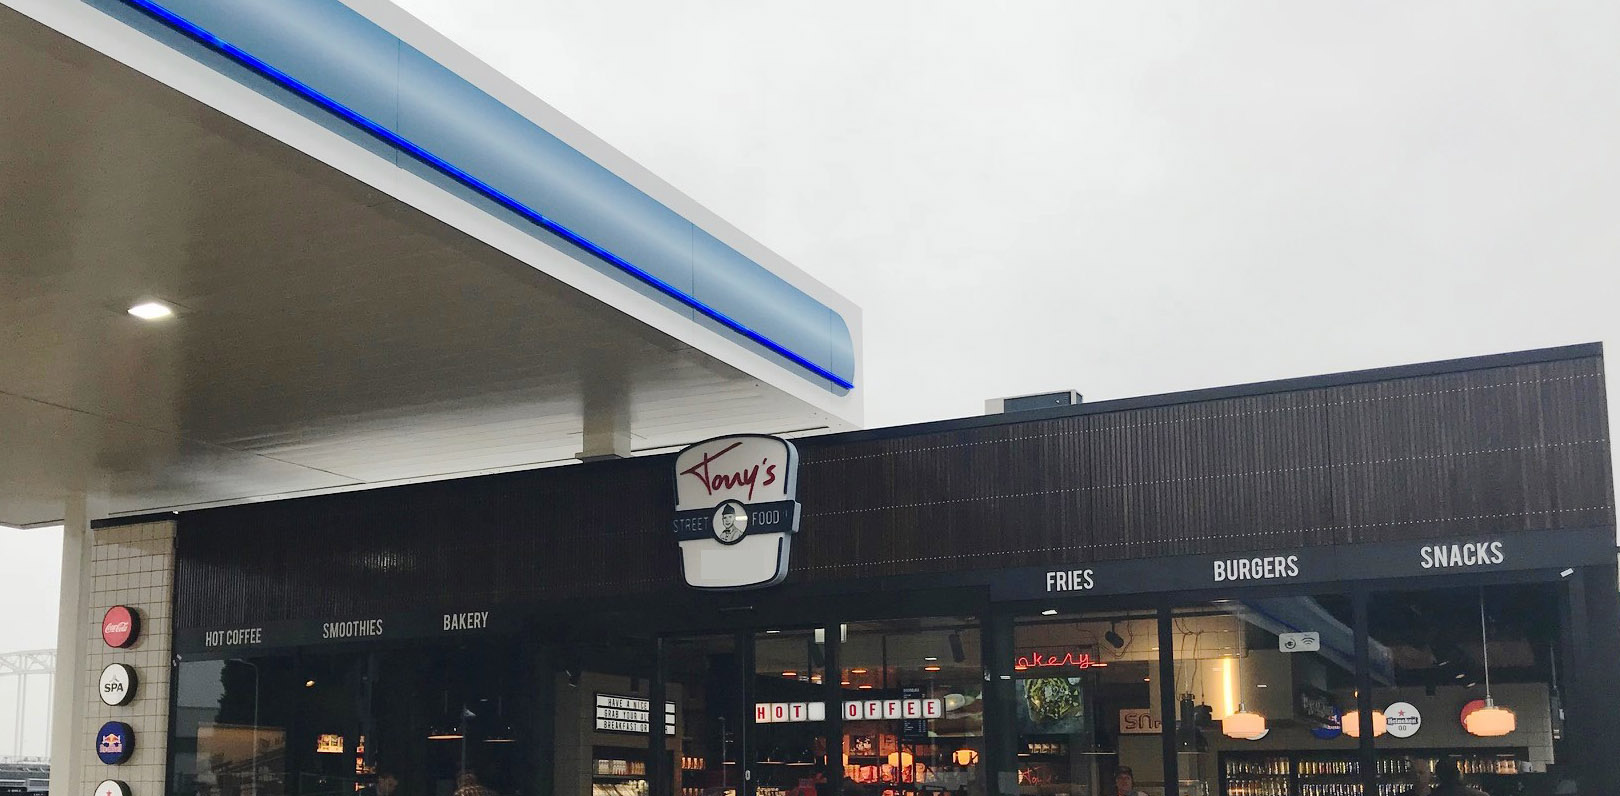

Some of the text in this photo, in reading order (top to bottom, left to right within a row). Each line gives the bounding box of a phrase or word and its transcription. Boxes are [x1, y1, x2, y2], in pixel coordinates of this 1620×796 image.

[680, 442, 776, 500] Tony's
[673, 510, 779, 533] STREET FOOD
[1420, 541, 1504, 569] SNACKS
[1213, 555, 1299, 582] BURGERS
[1046, 569, 1095, 592] FRIES
[322, 619, 383, 639] SMOOTHIES
[443, 611, 489, 631] BAKERY
[205, 628, 262, 647] HOT COFFEE
[1015, 652, 1096, 669] akery
[104, 682, 124, 692] SPA
[607, 699, 623, 708] HAVE
[757, 702, 935, 719] HOT OFFEE
[603, 720, 637, 731] BREAKFAST
